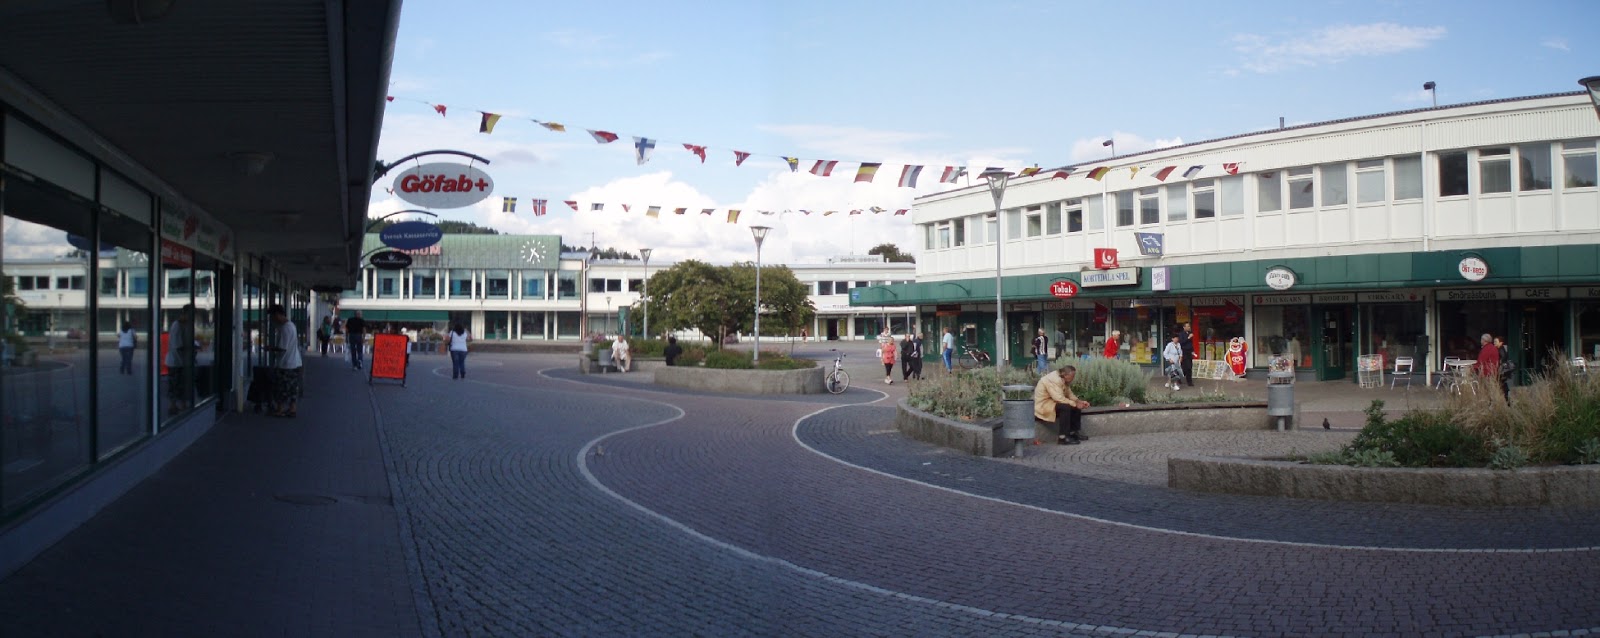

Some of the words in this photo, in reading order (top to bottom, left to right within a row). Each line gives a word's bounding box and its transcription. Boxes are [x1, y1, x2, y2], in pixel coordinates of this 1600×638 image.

[401, 174, 488, 193] Göfab+
[1116, 271, 1130, 281] SPEL
[1053, 284, 1073, 294] Tobak
